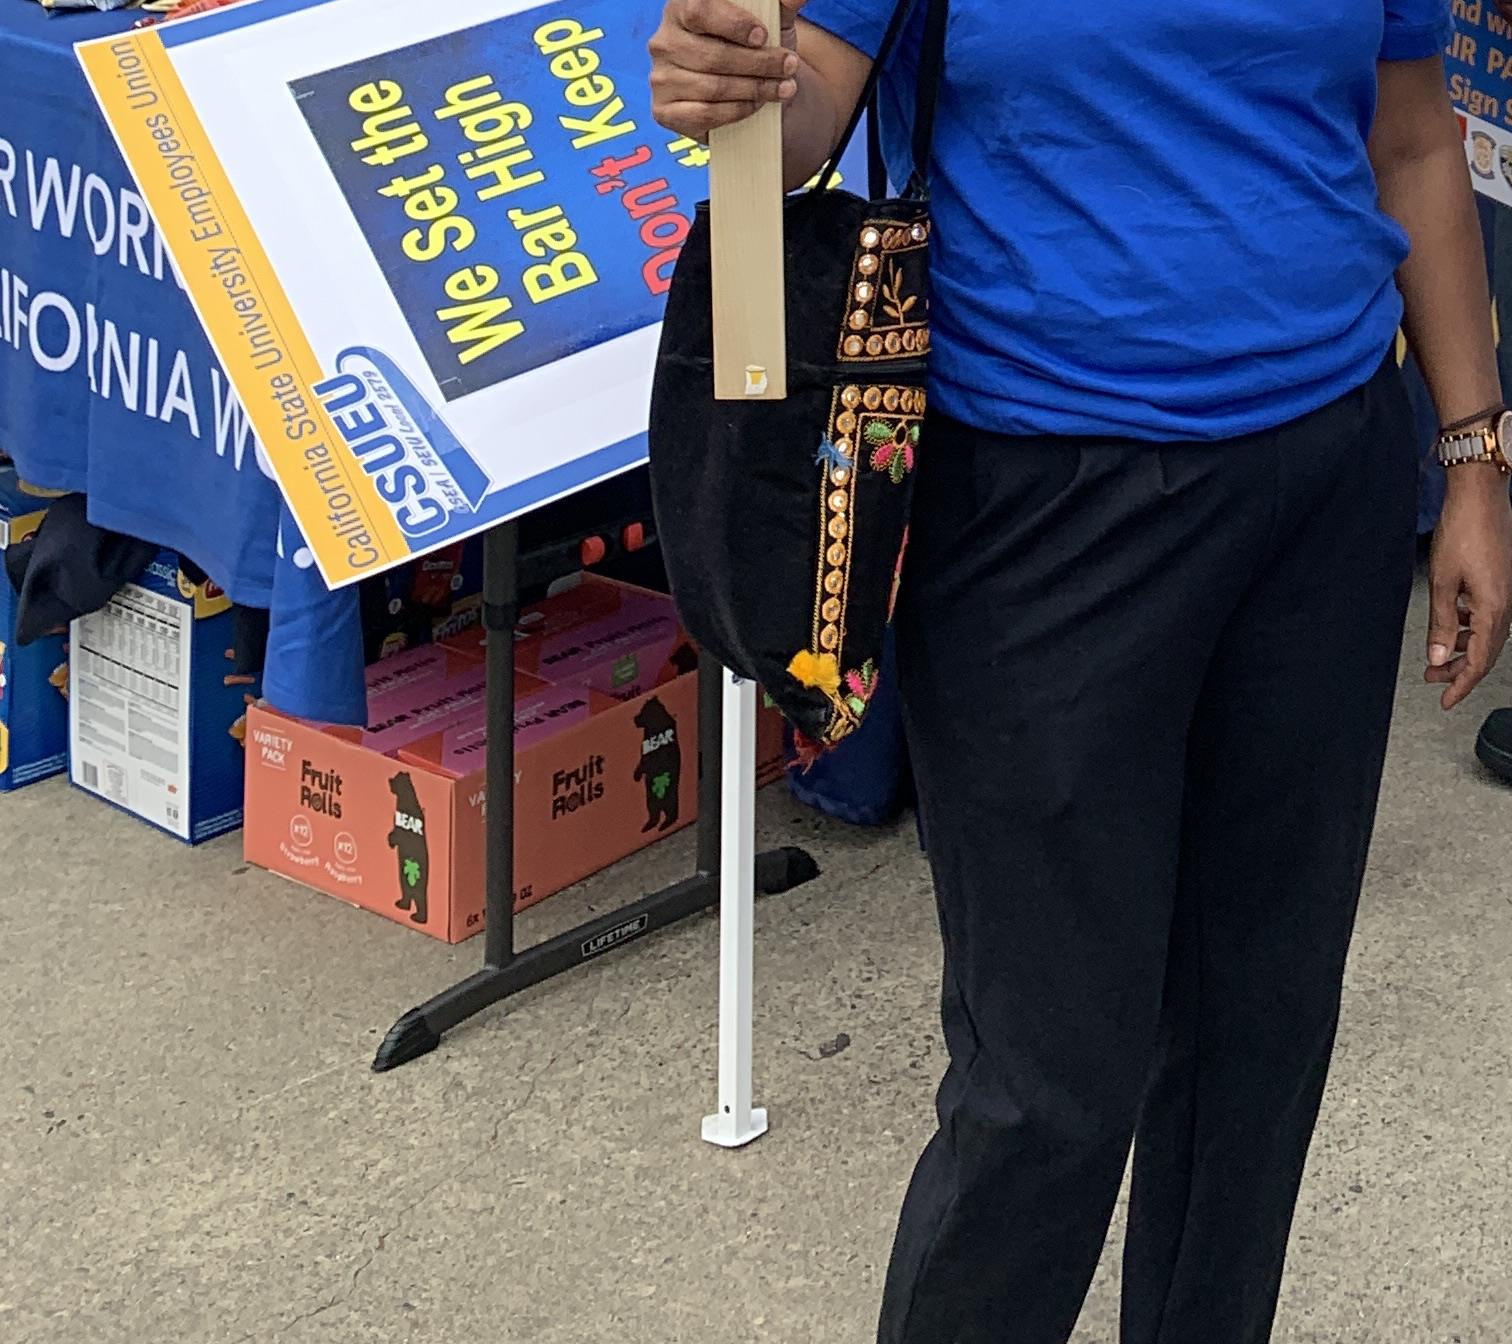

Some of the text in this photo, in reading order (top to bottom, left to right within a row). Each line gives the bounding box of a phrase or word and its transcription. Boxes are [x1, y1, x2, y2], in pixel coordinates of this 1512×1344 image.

[111, 39, 158, 110] Union
[531, 16, 638, 152] Keep
[1448, 73, 1499, 118] Sign
[145, 111, 224, 243] Employees
[433, 72, 600, 306] Bar High
[348, 77, 528, 367] We Set the
[208, 244, 283, 371] University
[0, 268, 201, 439] IFORNIA
[362, 370, 393, 402] 2579
[269, 372, 317, 442] State
[384, 402, 416, 439] Local
[312, 372, 449, 538] CSUEU
[405, 437, 440, 469] SEIU
[304, 440, 380, 569] California
[435, 478, 471, 514] CSEA
[253, 729, 294, 753] VARIETY
[261, 746, 286, 766] PACK
[642, 729, 674, 755] BEAR
[301, 759, 343, 796] Fruit
[552, 754, 605, 797] Fruit
[300, 784, 342, 820] Rolls
[552, 781, 605, 821] Rolls
[395, 810, 424, 836] BEAR
[589, 919, 641, 952] LIFETIME
